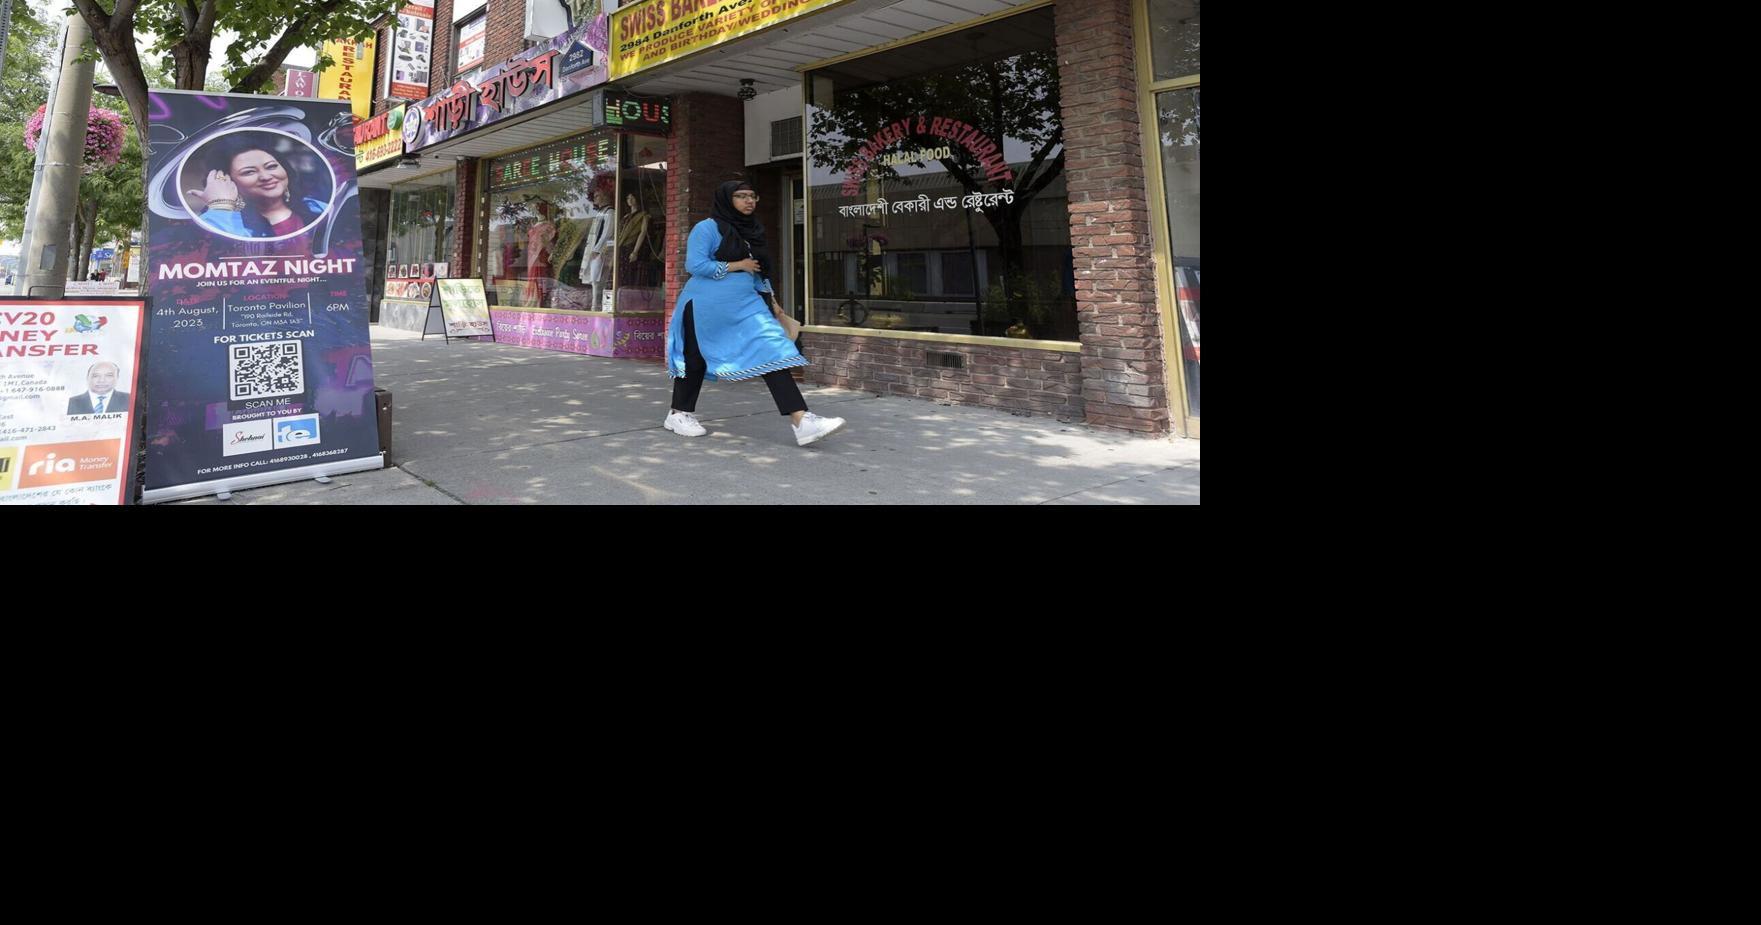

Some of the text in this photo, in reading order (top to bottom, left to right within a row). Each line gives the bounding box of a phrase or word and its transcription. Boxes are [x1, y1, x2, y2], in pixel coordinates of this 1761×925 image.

[620, 0, 665, 41] SWISS
[620, 35, 650, 52] 2984
[653, 12, 714, 39] Danforth
[620, 50, 635, 61] WE
[639, 29, 693, 54] PRODUCE
[697, 4, 755, 32] VARIETY
[643, 0, 810, 61] AND BIRTHDAY/WEDDIN
[338, 45, 356, 100] RESTAURAN
[859, 117, 911, 158] BAKERY
[916, 115, 926, 135] &
[930, 116, 1013, 182] RESTAURANT
[882, 145, 951, 167] HALAL FOOD
[838, 197, 889, 218] বাংলাদেশী
[891, 193, 930, 215] বেকারী
[934, 196, 957, 211] এন্ড
[158, 260, 278, 280] MOMTAZ
[284, 258, 356, 275] NIGHT
[156, 306, 219, 316] 4th August,
[228, 301, 305, 312] Toronto Pavilion
[326, 303, 349, 312] 6PM
[0, 312, 56, 325] V20
[173, 319, 203, 328] 2023
[0, 329, 58, 342] NEY
[213, 330, 315, 344] FOR TICKETS SCAN
[0, 344, 99, 357] NSFER
[245, 398, 291, 409] SCAN ME
[232, 411, 265, 421] BROUGHT
[28, 452, 76, 476] ria
[197, 465, 212, 475] FOR
[212, 464, 232, 473] MORE
[233, 462, 249, 470] INFO
[250, 459, 268, 467] CALL:
